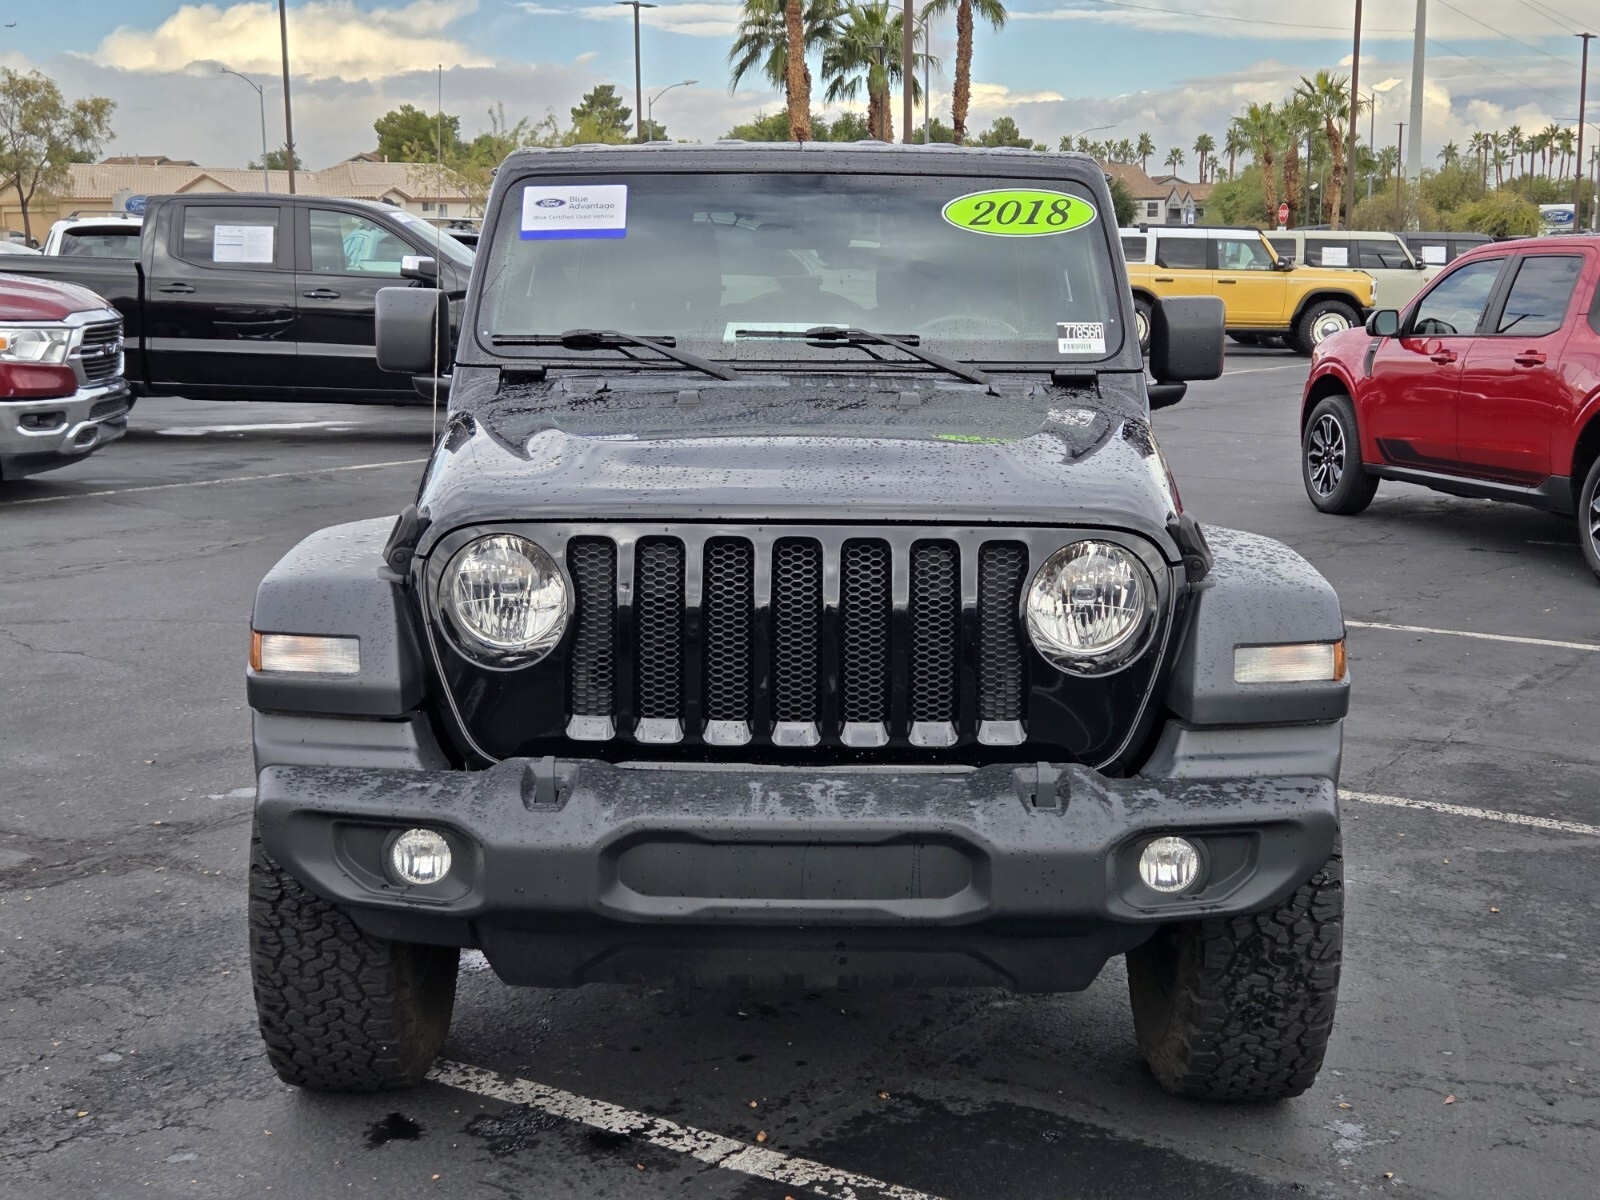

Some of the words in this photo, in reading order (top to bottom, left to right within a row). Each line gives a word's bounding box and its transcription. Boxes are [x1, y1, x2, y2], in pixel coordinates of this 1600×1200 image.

[130, 199, 147, 210] For
[540, 199, 561, 207] Ford
[968, 199, 1072, 226] 2018
[1546, 211, 1570, 221] Ford
[1063, 324, 1102, 339] 77856A
